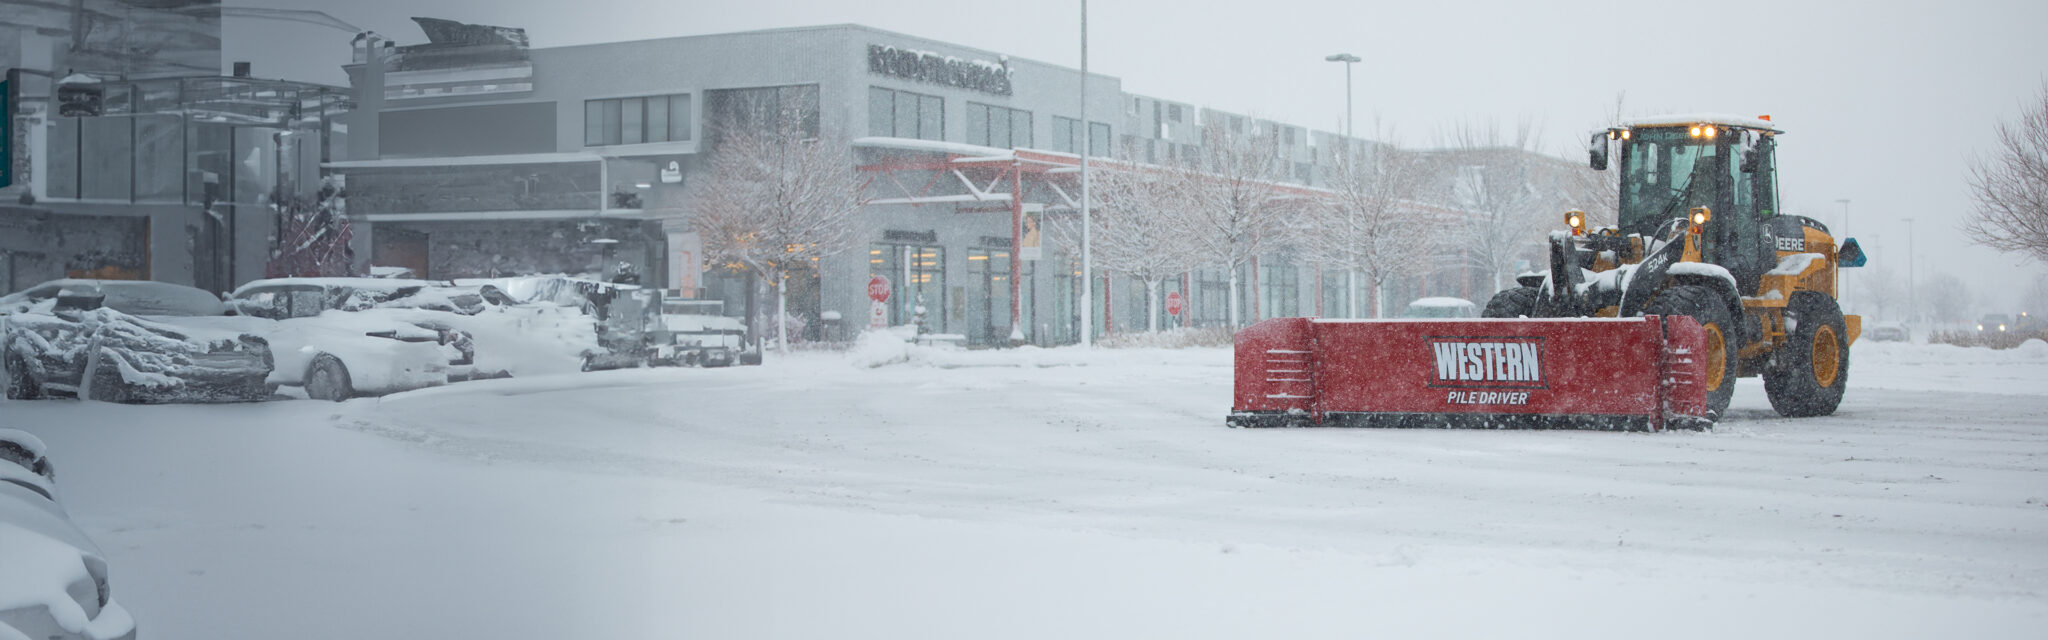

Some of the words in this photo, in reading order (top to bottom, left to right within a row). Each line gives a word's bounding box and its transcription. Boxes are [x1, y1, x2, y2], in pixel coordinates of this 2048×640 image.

[1665, 131, 1691, 140] DEER
[869, 284, 889, 296] STOP
[1433, 342, 1539, 382] WESTERN
[1447, 391, 1478, 405] PILE
[1479, 391, 1528, 405] DRIVER
